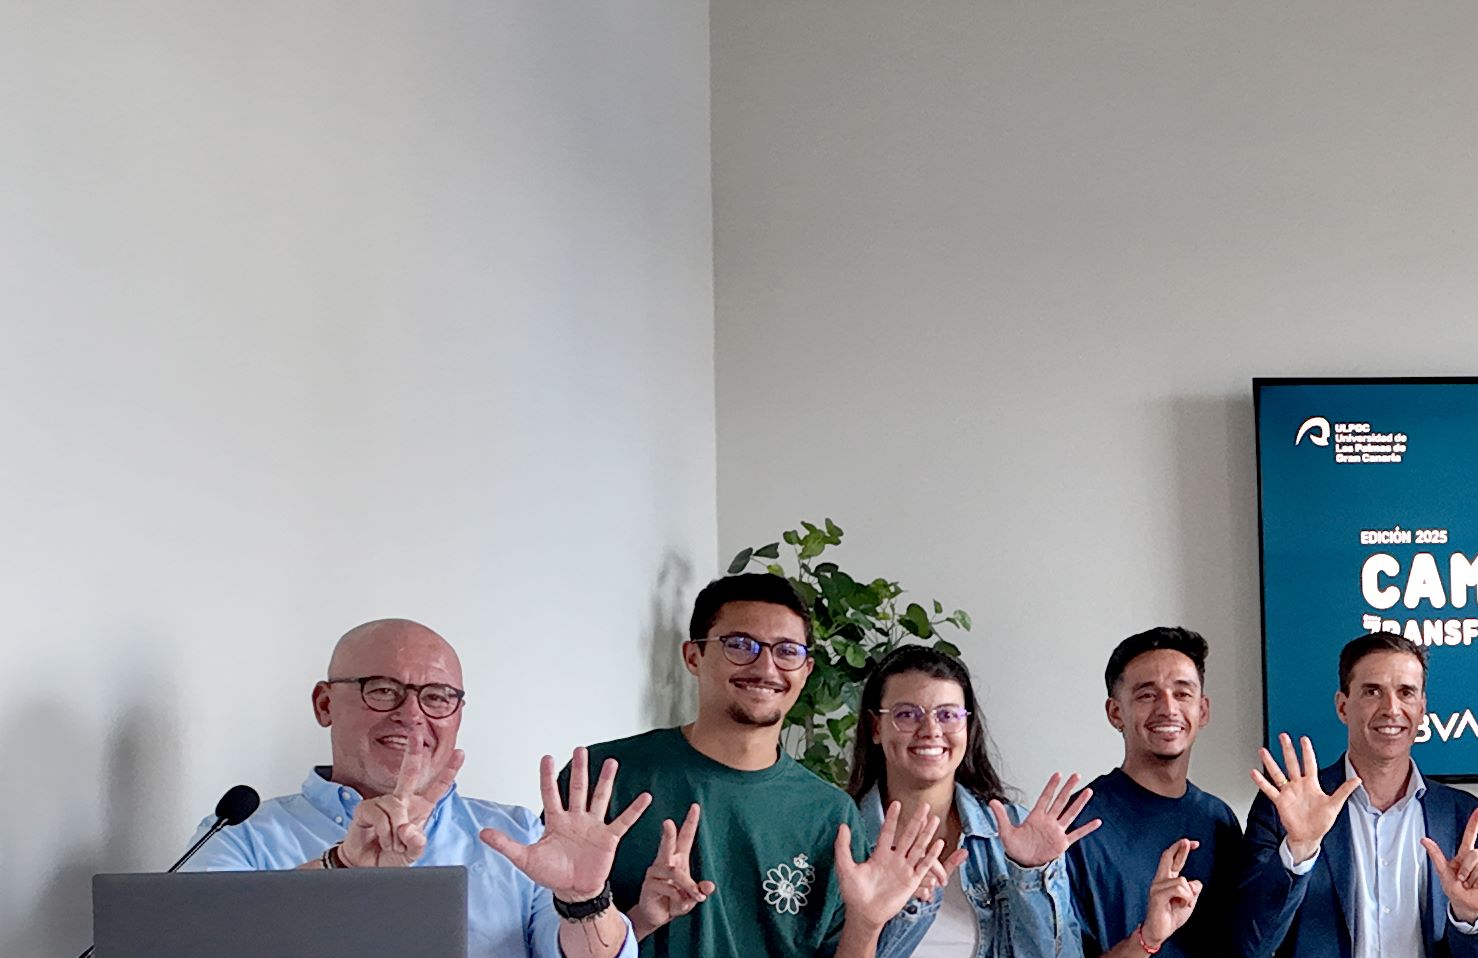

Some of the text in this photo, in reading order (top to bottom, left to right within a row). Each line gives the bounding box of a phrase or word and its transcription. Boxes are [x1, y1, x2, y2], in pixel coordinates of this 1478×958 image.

[1335, 423, 1371, 433] ULPGC
[1360, 525, 1448, 545] EDICIÓN 2025
